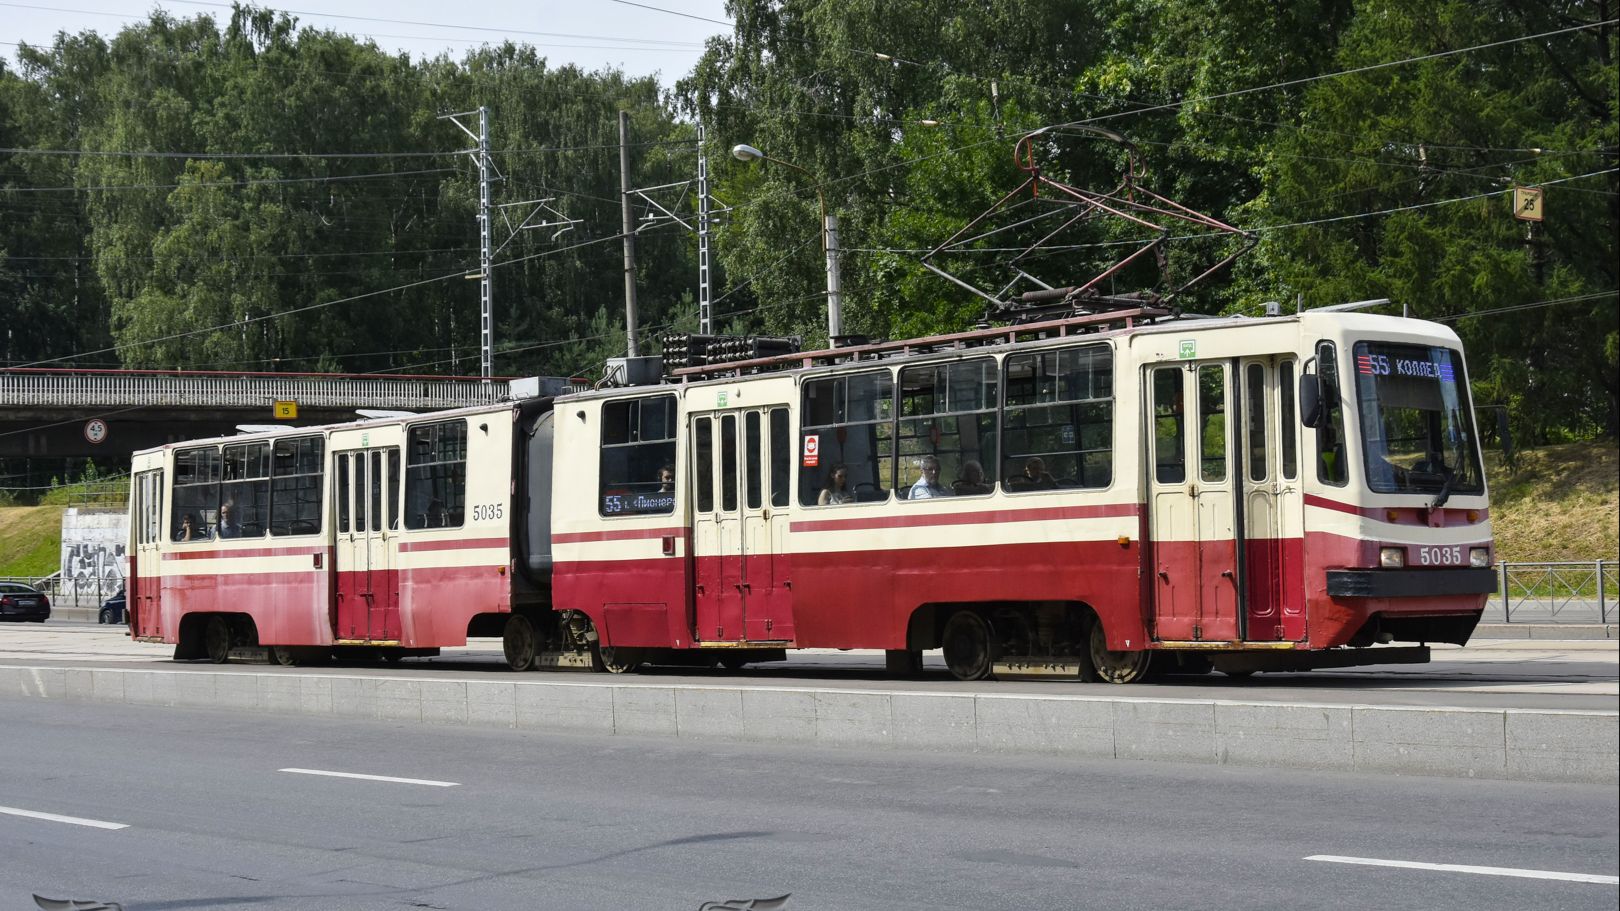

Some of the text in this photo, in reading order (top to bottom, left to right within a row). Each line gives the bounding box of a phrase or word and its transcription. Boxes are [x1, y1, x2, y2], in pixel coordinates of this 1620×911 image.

[1524, 198, 1534, 211] 25
[1369, 354, 1390, 375] 55
[282, 407, 289, 415] 15
[473, 503, 503, 521] 5035
[606, 495, 621, 512] 55
[1420, 546, 1461, 565] 5035
